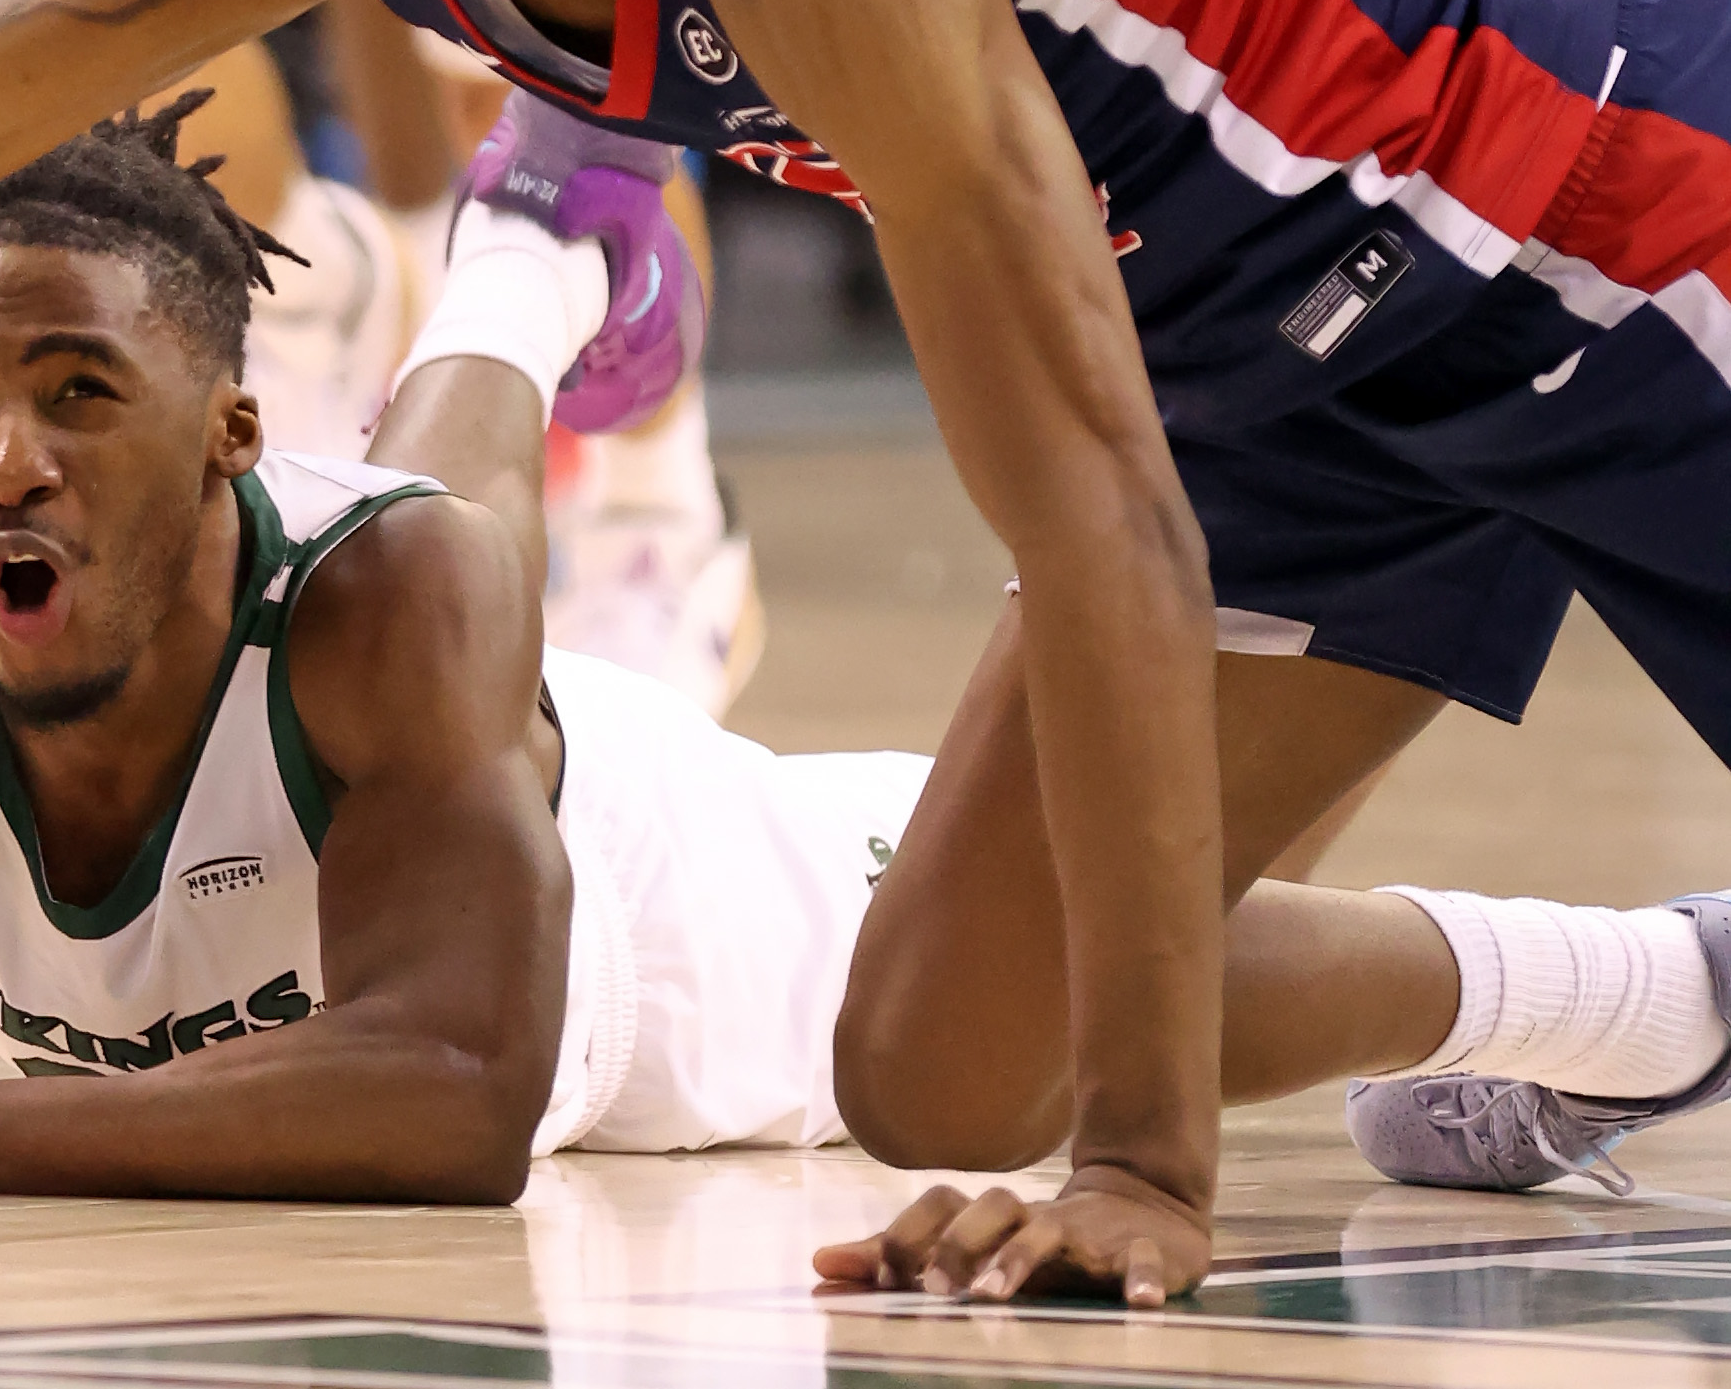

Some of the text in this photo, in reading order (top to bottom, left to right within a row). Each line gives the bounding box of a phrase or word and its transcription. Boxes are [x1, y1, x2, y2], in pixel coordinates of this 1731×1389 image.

[687, 29, 723, 64] EC
[1356, 249, 1388, 282] M
[1285, 274, 1340, 333] ENGINEERED
[186, 862, 262, 890] HORIZON
